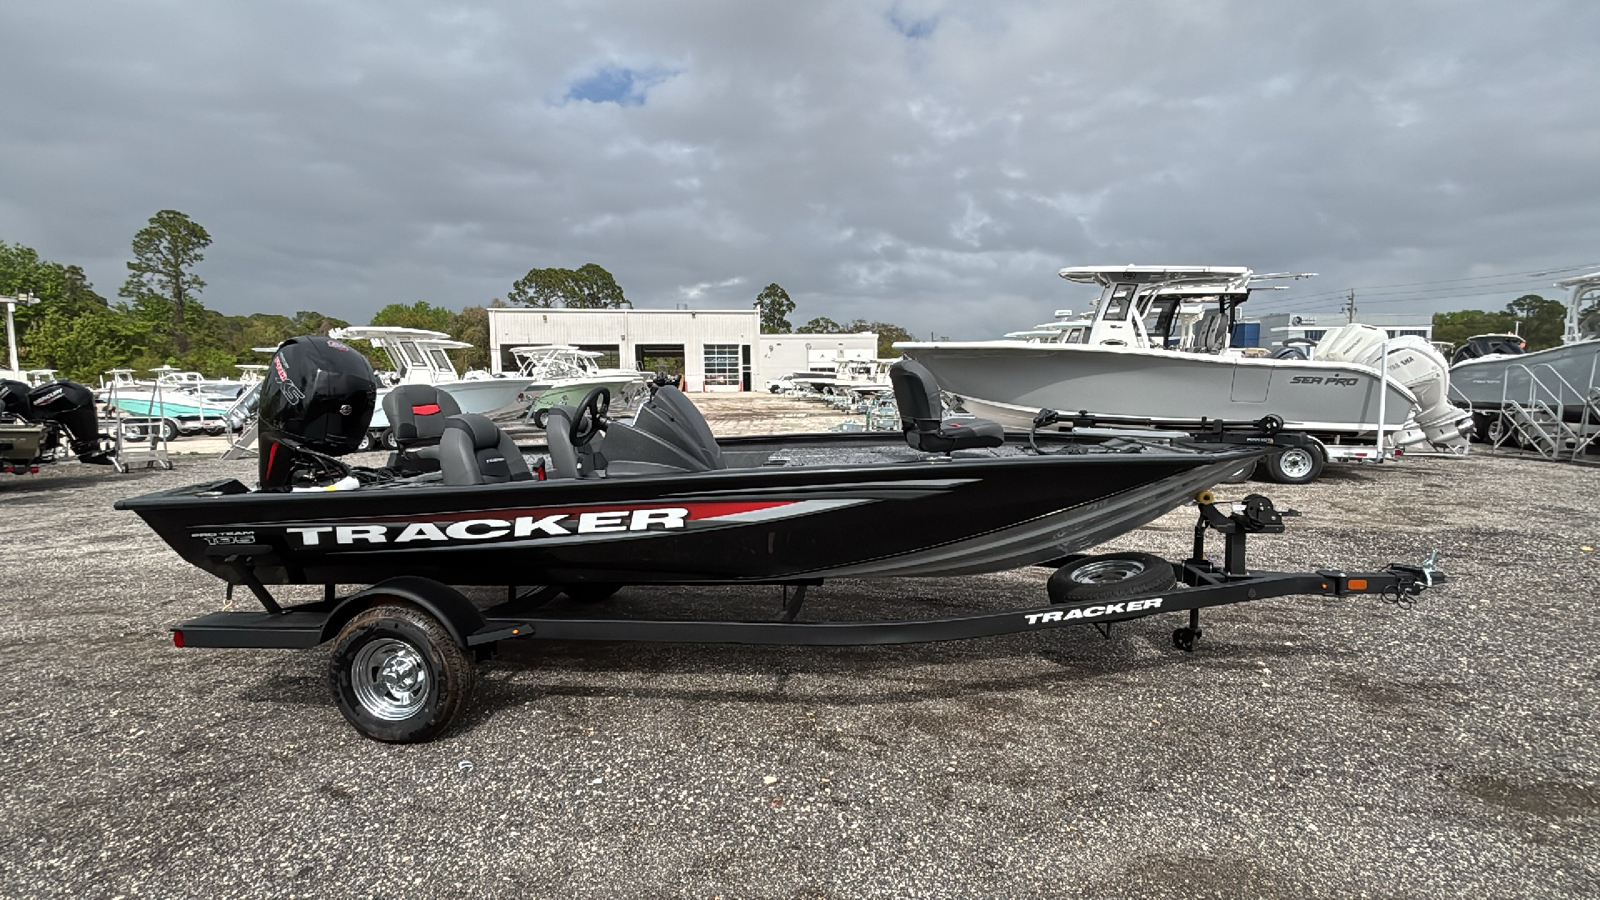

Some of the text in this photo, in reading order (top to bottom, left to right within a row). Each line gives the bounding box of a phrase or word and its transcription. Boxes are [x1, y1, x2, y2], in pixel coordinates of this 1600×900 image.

[1289, 376, 1359, 387] SEA PRO
[286, 507, 689, 545] TRACKER
[1024, 597, 1163, 625] TRACKER
